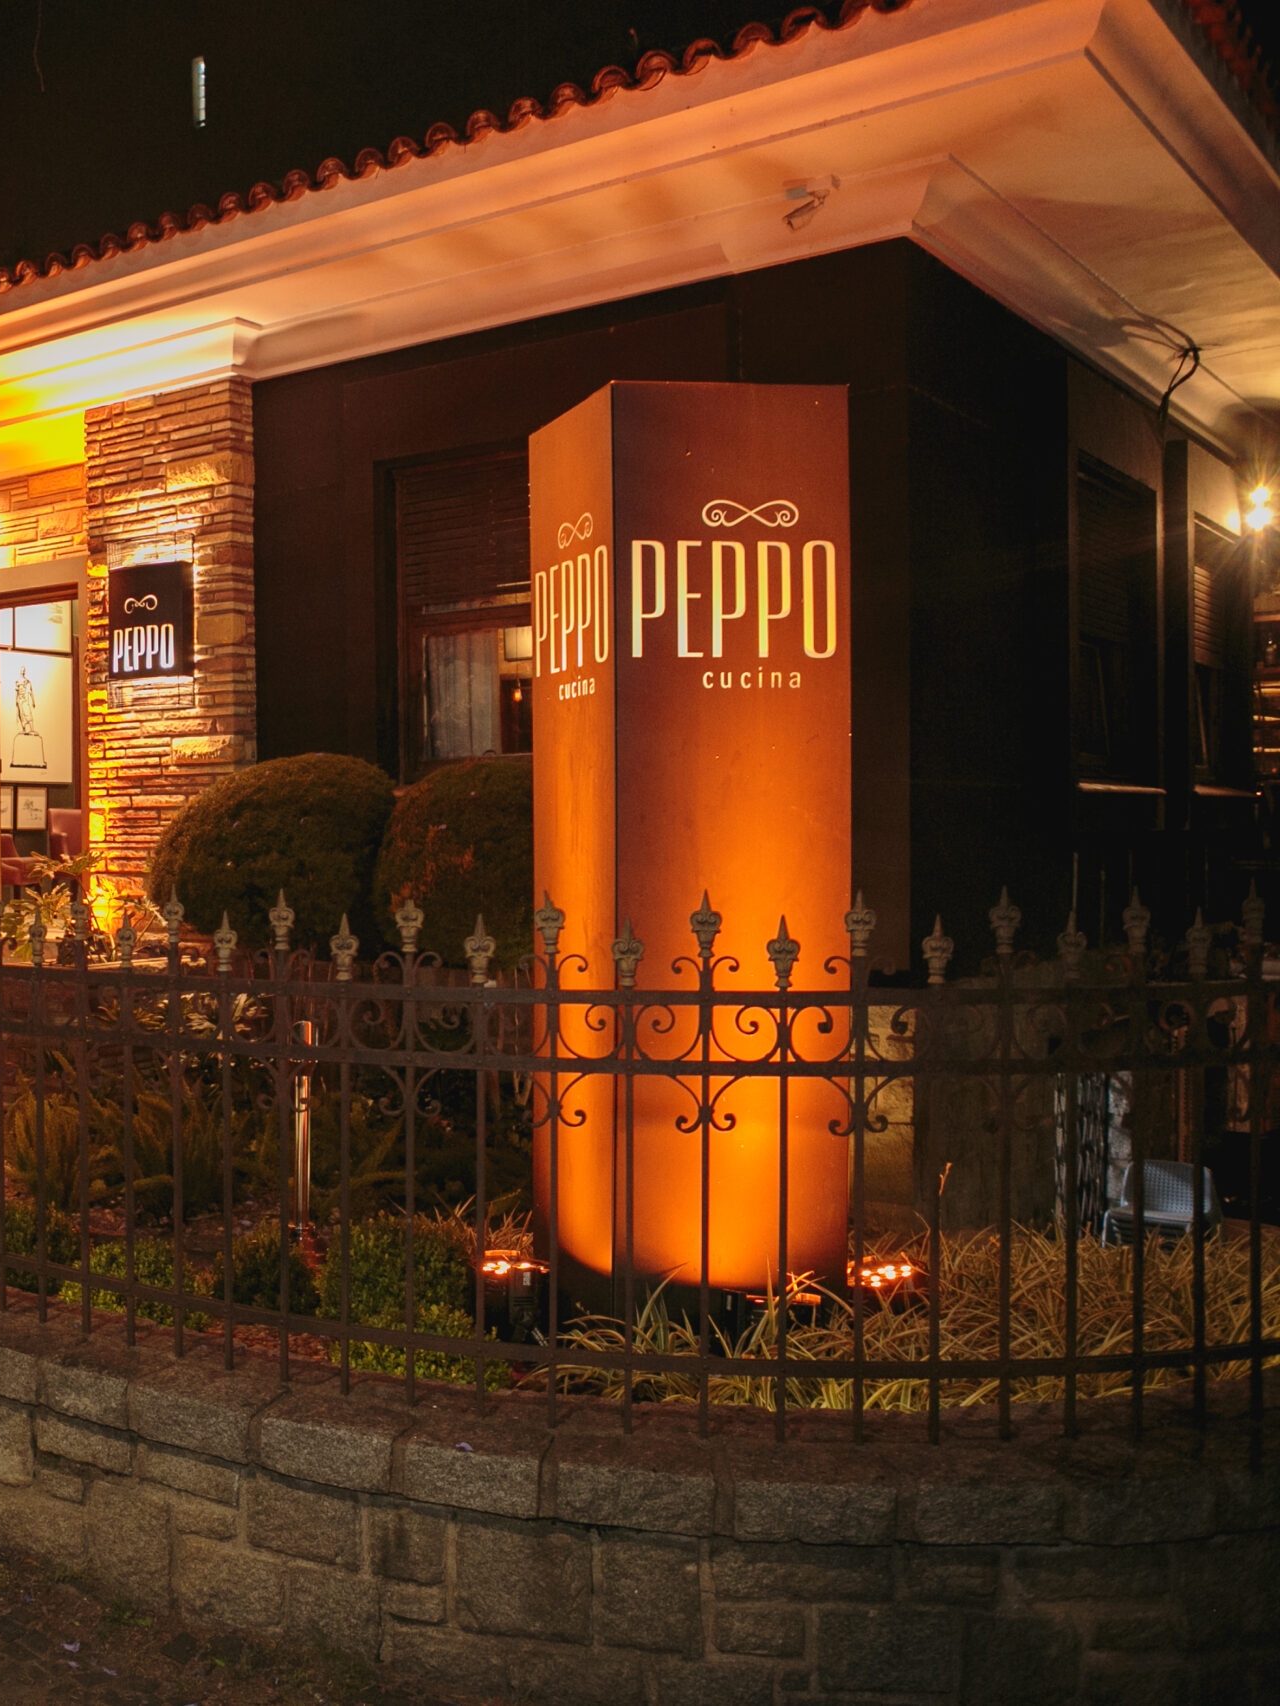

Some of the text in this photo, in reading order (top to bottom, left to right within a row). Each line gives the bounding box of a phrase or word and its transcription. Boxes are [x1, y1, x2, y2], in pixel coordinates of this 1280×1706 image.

[535, 545, 609, 678] PEPPO
[632, 540, 837, 659] PEPPO
[113, 623, 175, 673] PEPPO
[558, 675, 596, 701] cucina
[702, 666, 802, 689] cucina
